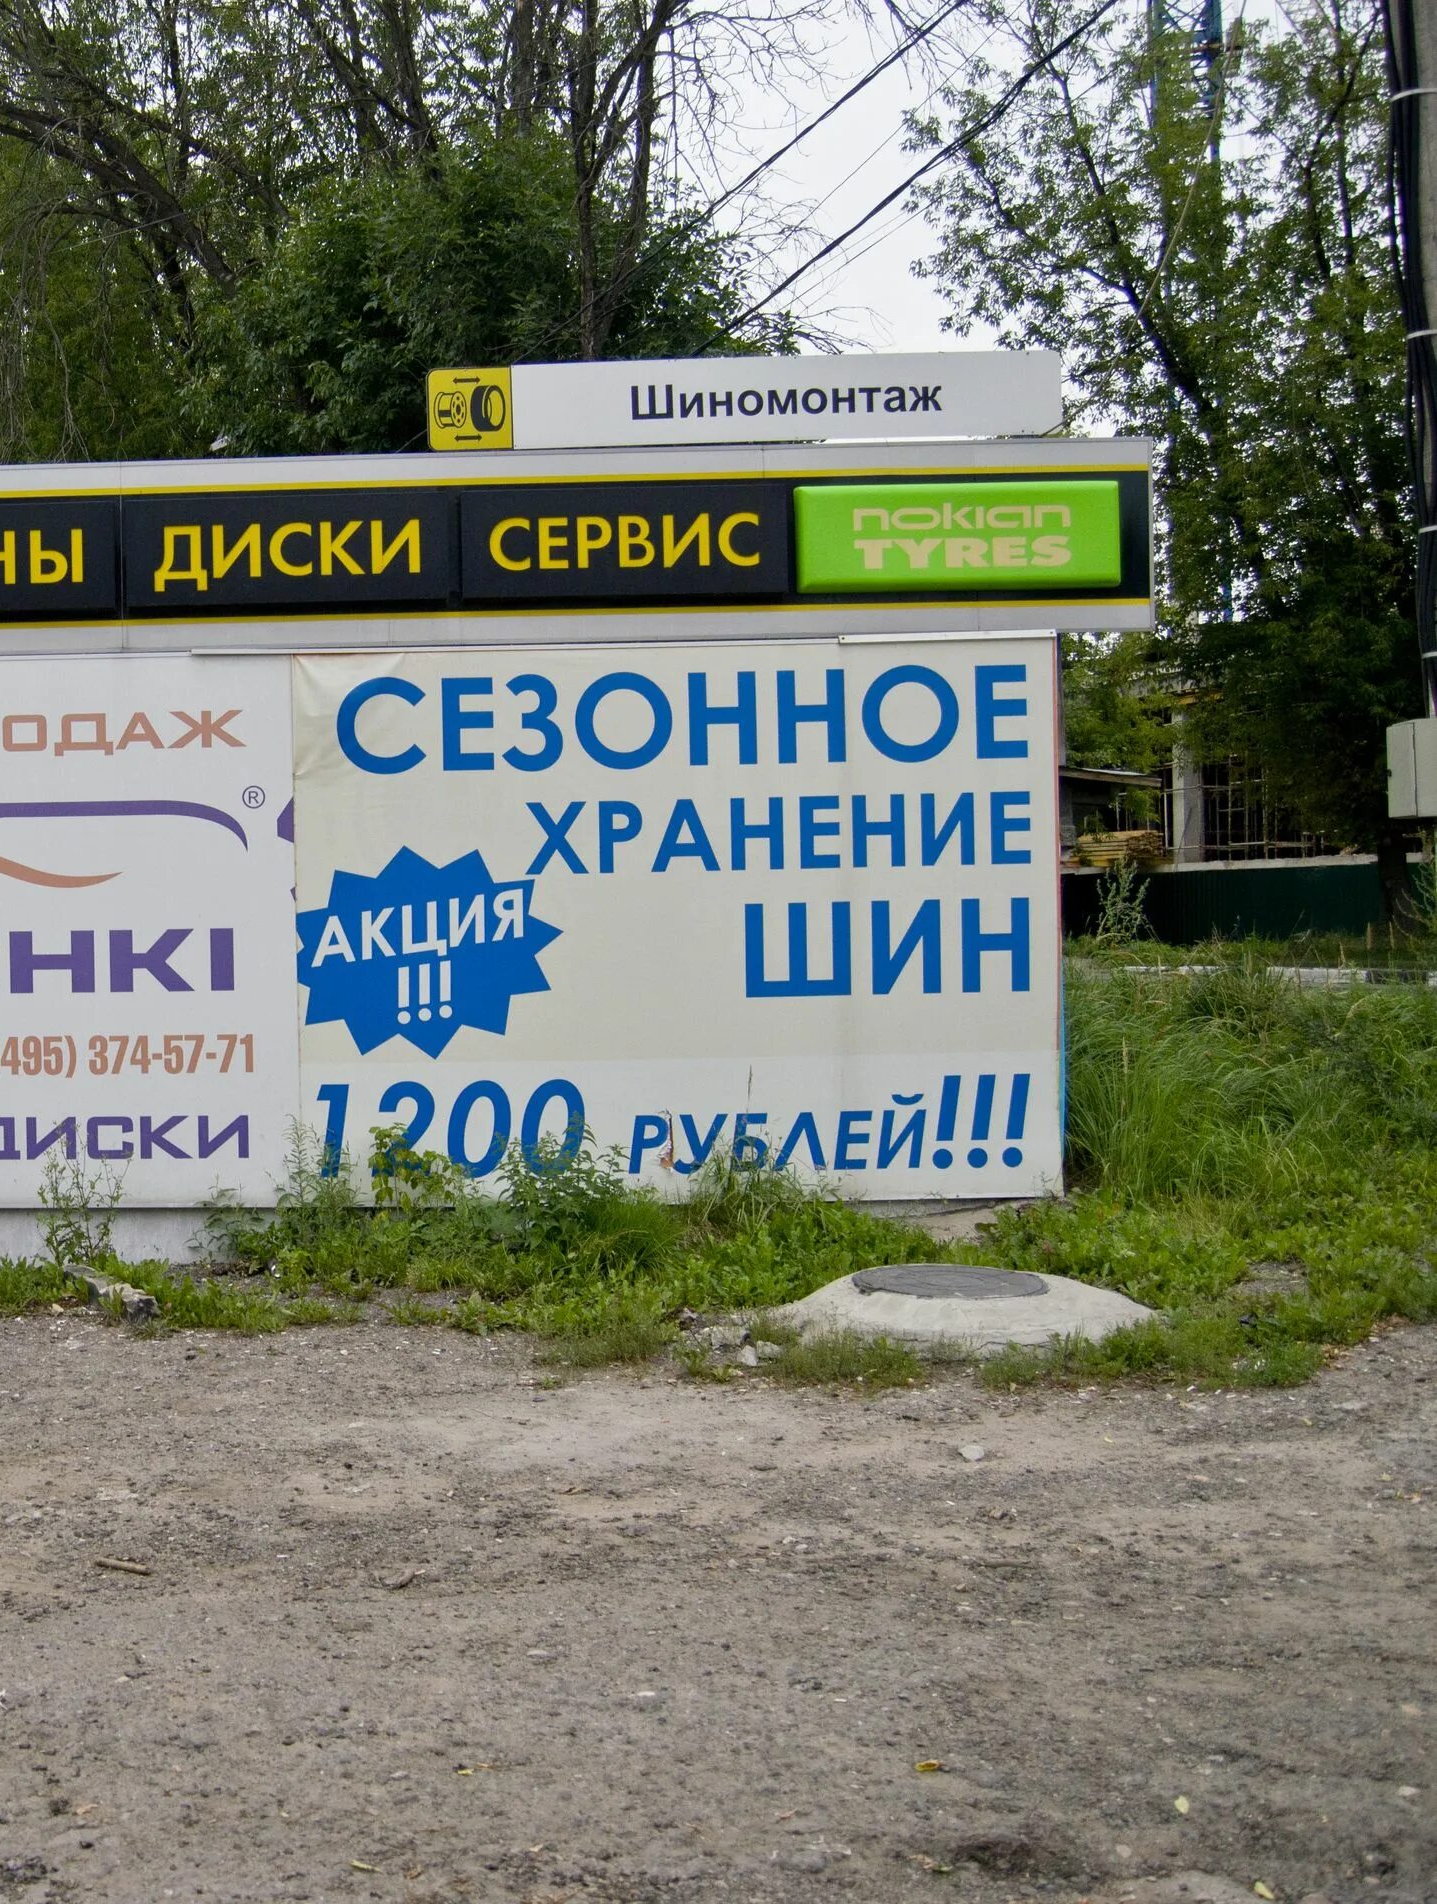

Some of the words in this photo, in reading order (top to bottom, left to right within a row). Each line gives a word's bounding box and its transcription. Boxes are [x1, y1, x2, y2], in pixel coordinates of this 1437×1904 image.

[630, 380, 943, 420] Шиномонтаж
[153, 519, 421, 592] ДИСКИ
[488, 511, 762, 571] СЕРВИС
[853, 535, 1072, 570] TYRES
[335, 663, 1029, 774] СЕЗОННОЕ
[525, 790, 1032, 876] ХРАНЕНИЕ
[310, 887, 527, 968] АКЦИЯ
[744, 897, 1031, 998] ШИН
[396, 960, 454, 1025] !!!
[88, 1033, 255, 1077] 374-57-71
[315, 1078, 585, 1179] 1200
